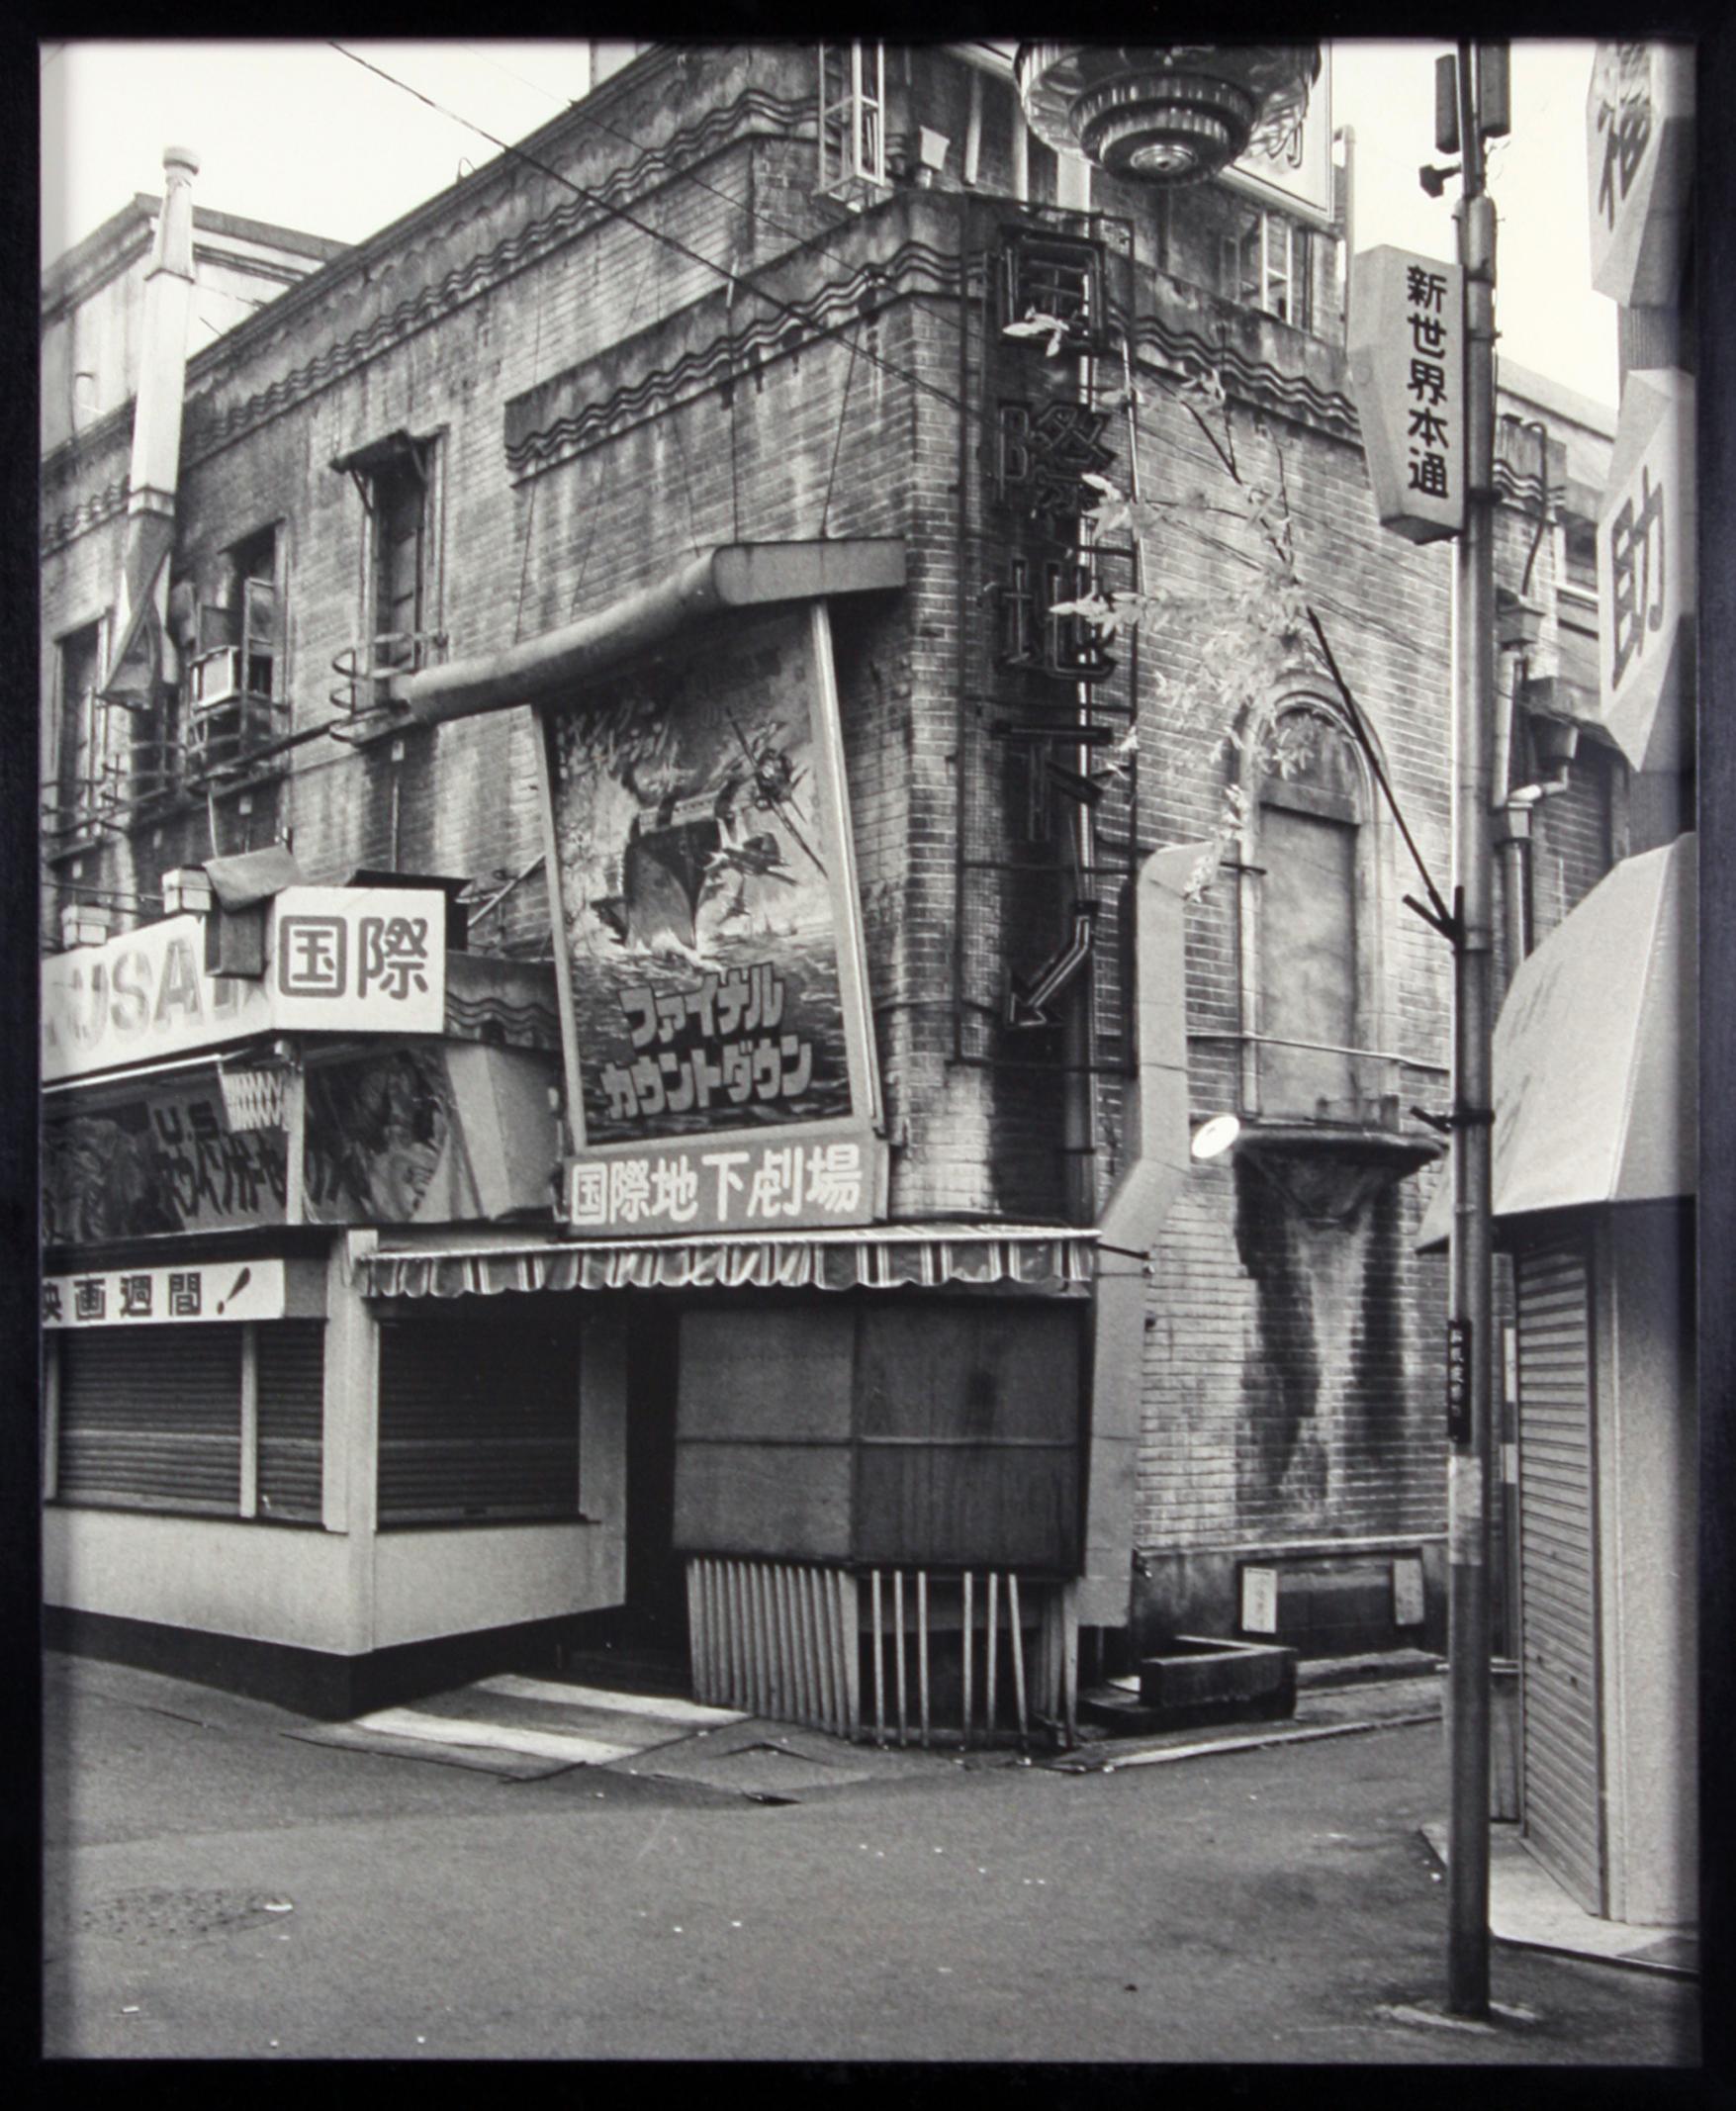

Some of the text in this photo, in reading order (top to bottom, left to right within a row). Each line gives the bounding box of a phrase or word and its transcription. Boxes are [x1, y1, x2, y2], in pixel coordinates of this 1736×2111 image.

[1406, 263, 1450, 500] 新世界本通
[279, 915, 429, 1000] 国際
[618, 962, 784, 1049] ファイナル
[599, 1034, 813, 1121] カウントダウン
[571, 1143, 863, 1226] 国際地下劇場
